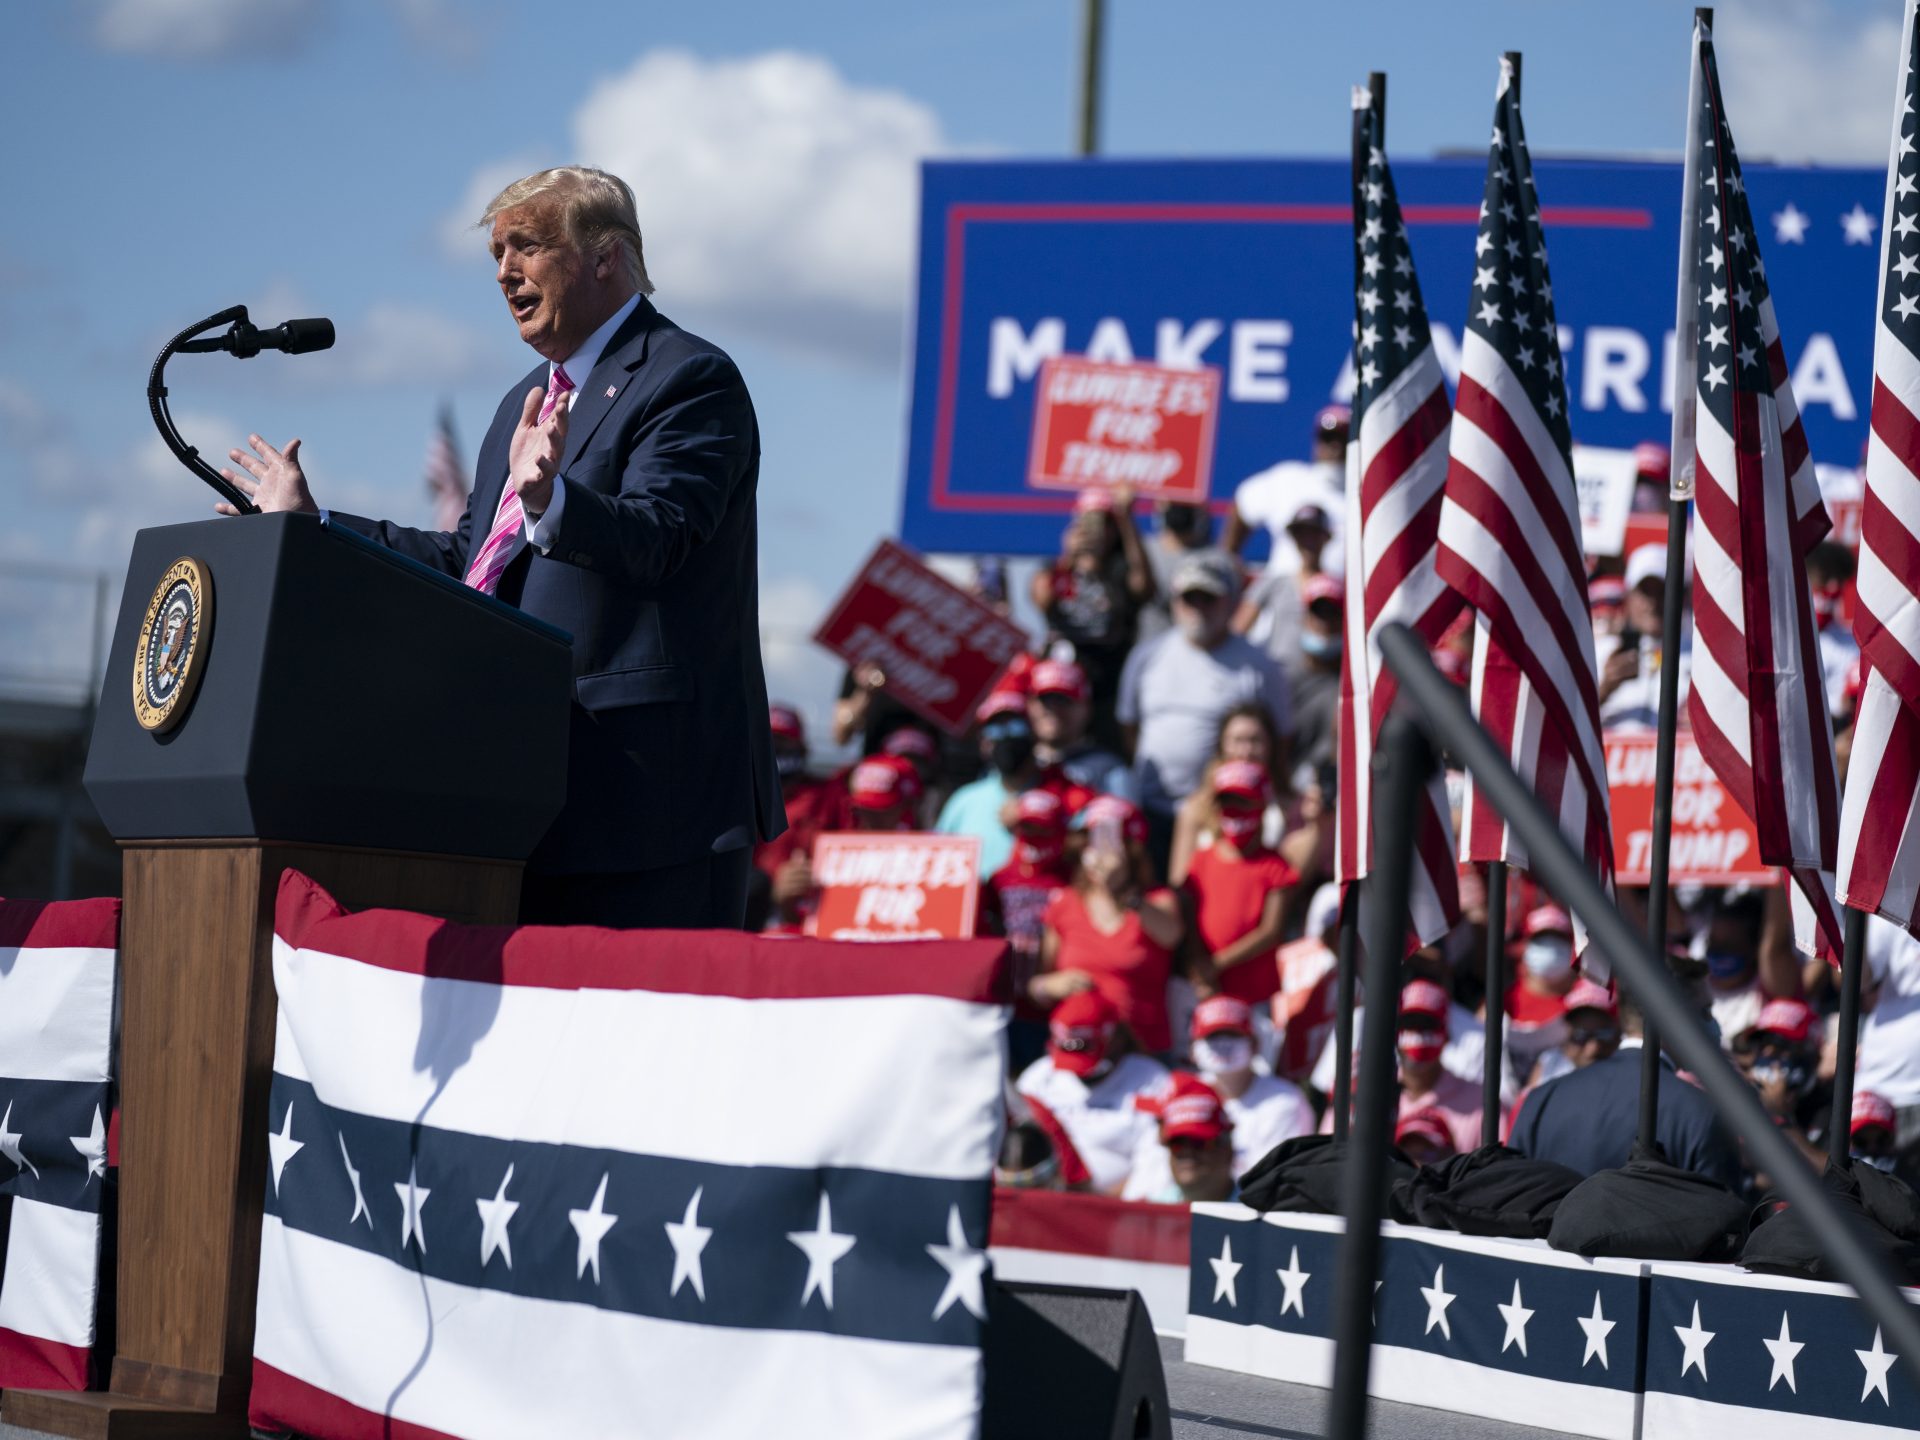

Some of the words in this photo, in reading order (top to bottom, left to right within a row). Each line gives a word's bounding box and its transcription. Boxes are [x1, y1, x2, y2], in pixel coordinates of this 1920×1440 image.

[987, 316, 1293, 402] MAKE
[1330, 320, 1857, 421] MRIA
[1087, 405, 1161, 449] FOR
[1059, 441, 1183, 489] TRUMP
[138, 643, 146, 666] THE
[142, 563, 184, 637] PRESIDENT
[886, 607, 961, 666] FOR
[842, 622, 957, 704] TRUMP
[854, 884, 926, 928] FOR
